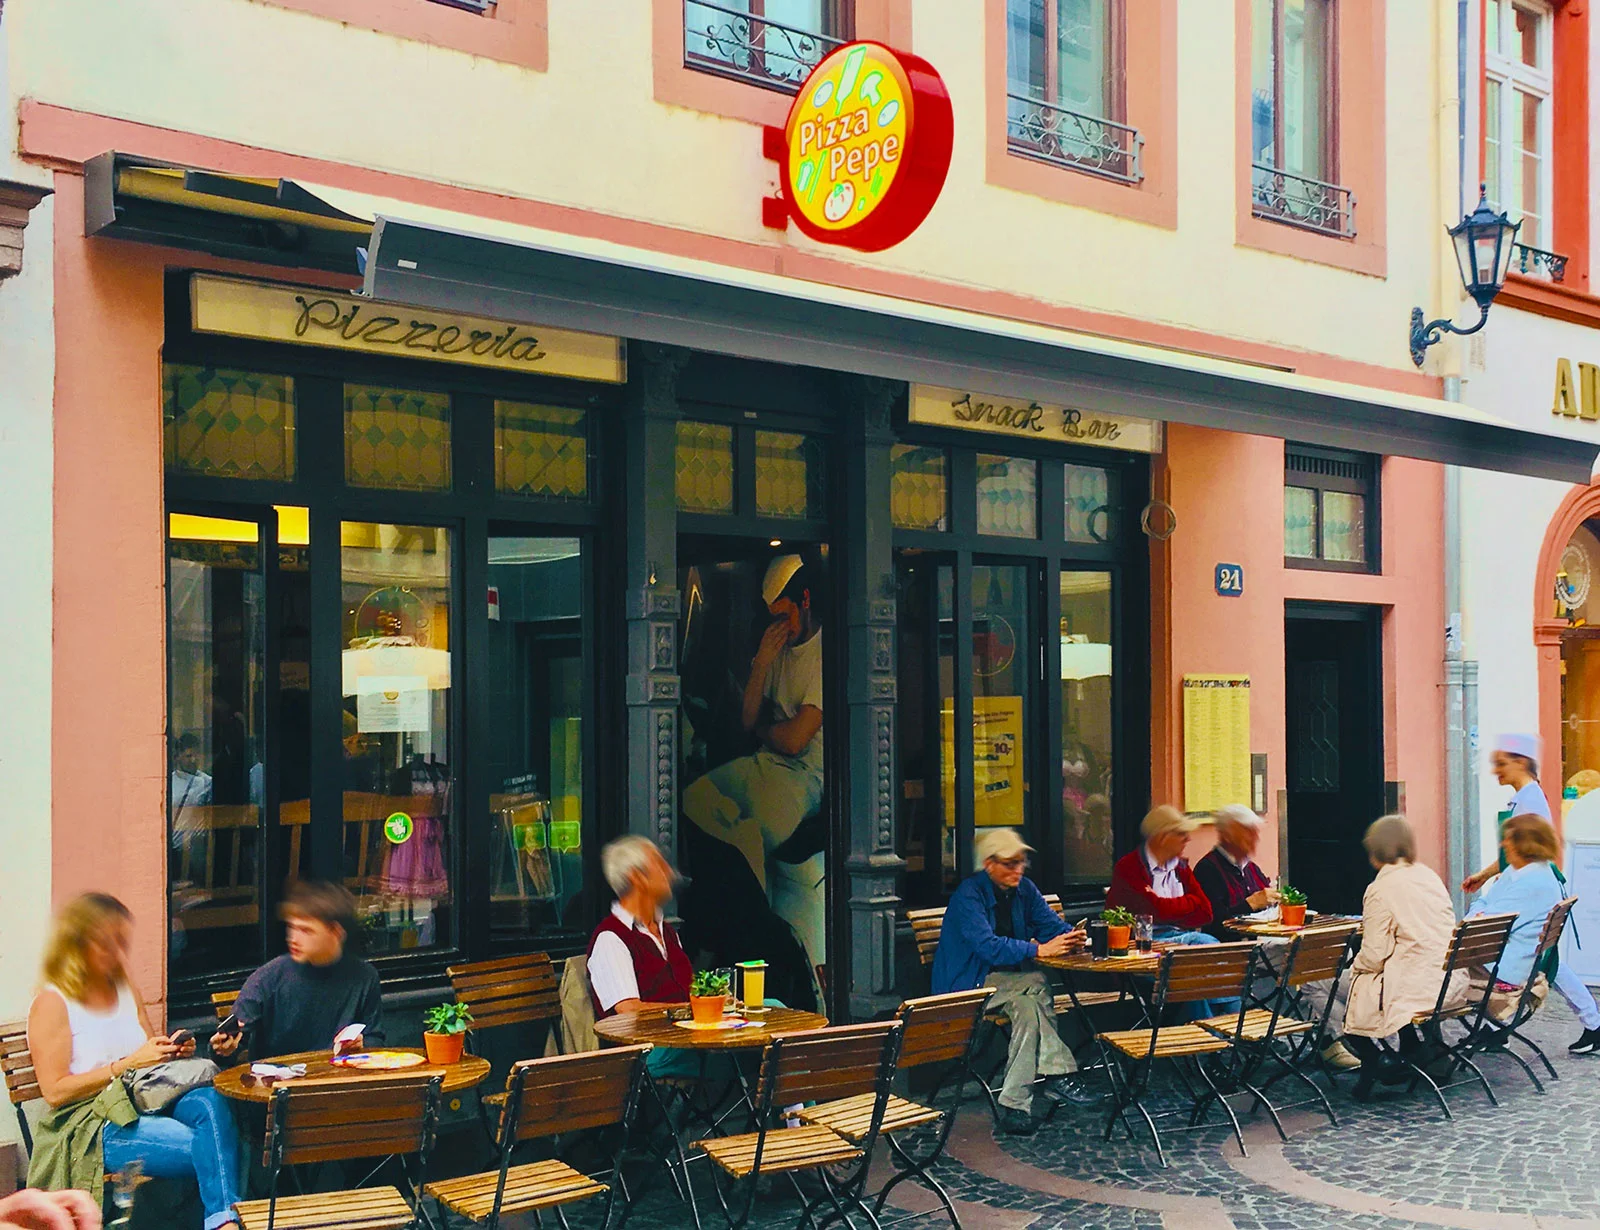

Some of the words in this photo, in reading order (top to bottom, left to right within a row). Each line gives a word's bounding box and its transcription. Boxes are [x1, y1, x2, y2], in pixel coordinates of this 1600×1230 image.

[799, 106, 869, 157] Pizza
[829, 134, 899, 182] Pepe
[294, 295, 546, 362] Pizzeria
[951, 393, 1044, 432] Snack
[1062, 408, 1121, 441] Bar
[1219, 568, 1242, 591] 21
